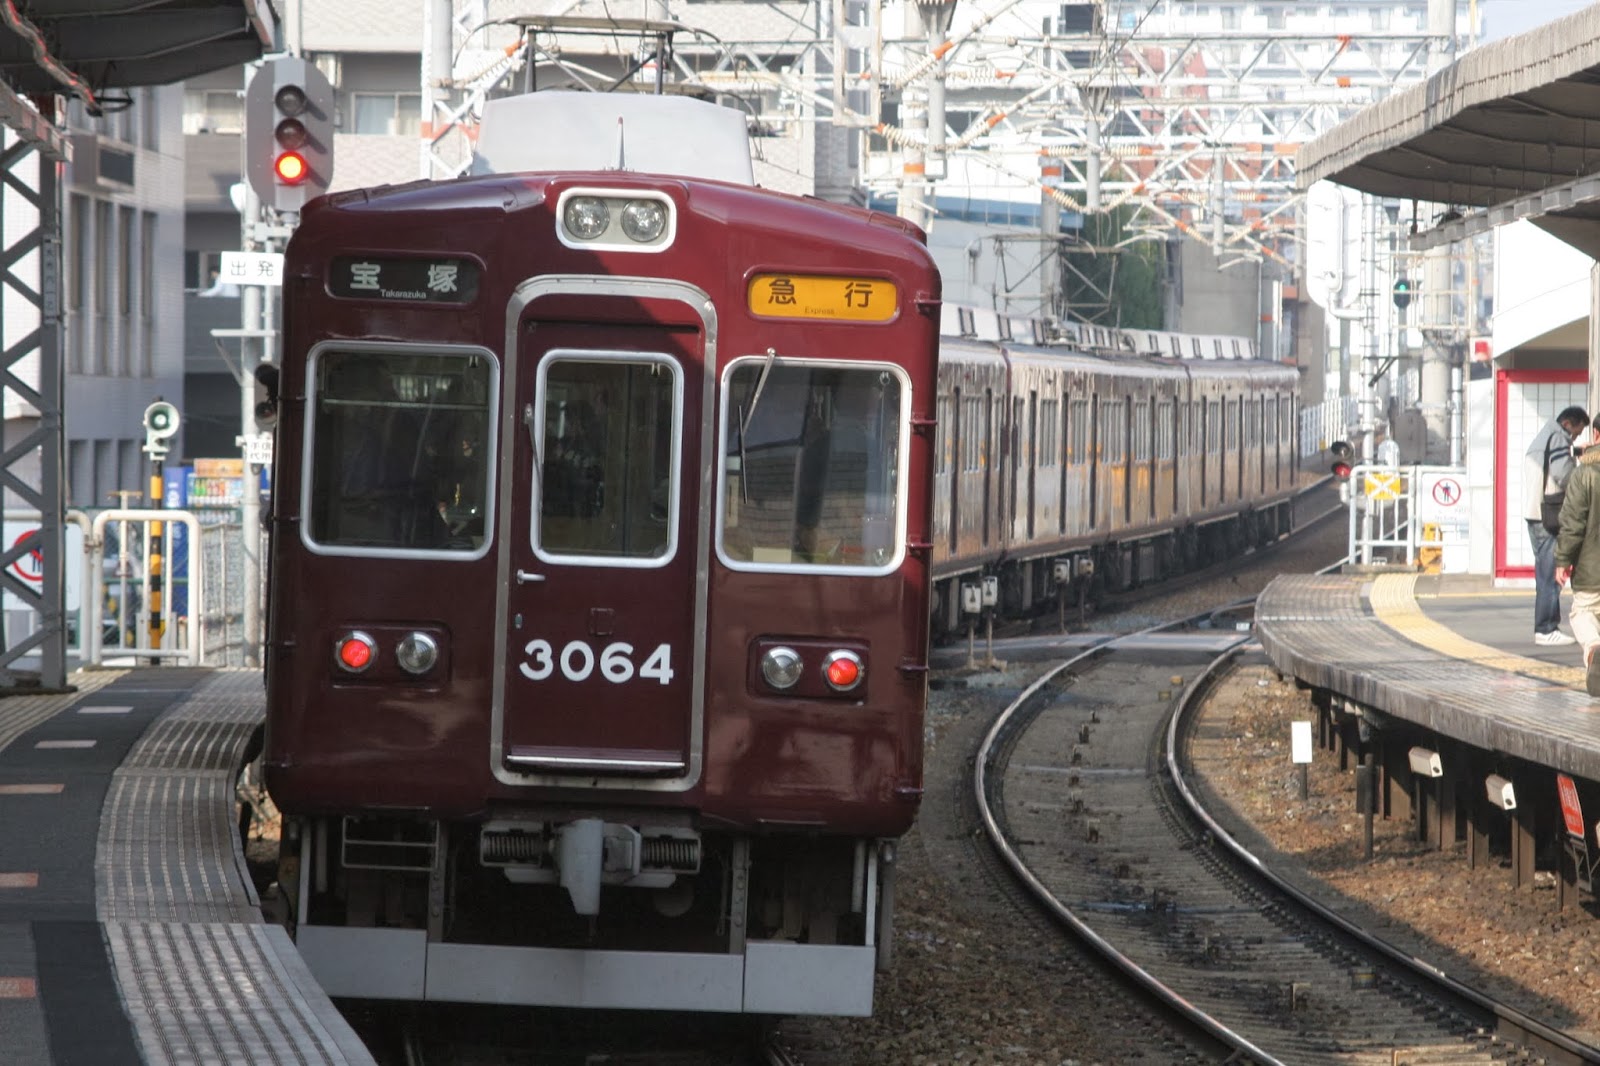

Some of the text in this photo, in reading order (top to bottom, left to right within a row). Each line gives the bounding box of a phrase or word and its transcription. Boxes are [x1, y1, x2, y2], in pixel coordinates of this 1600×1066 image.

[230, 260, 274, 277] 出発
[350, 262, 458, 293] 宝塚
[380, 288, 427, 299] Takarazuka
[768, 278, 874, 309] 急行
[804, 306, 835, 316] Express
[519, 638, 674, 685] 3064
